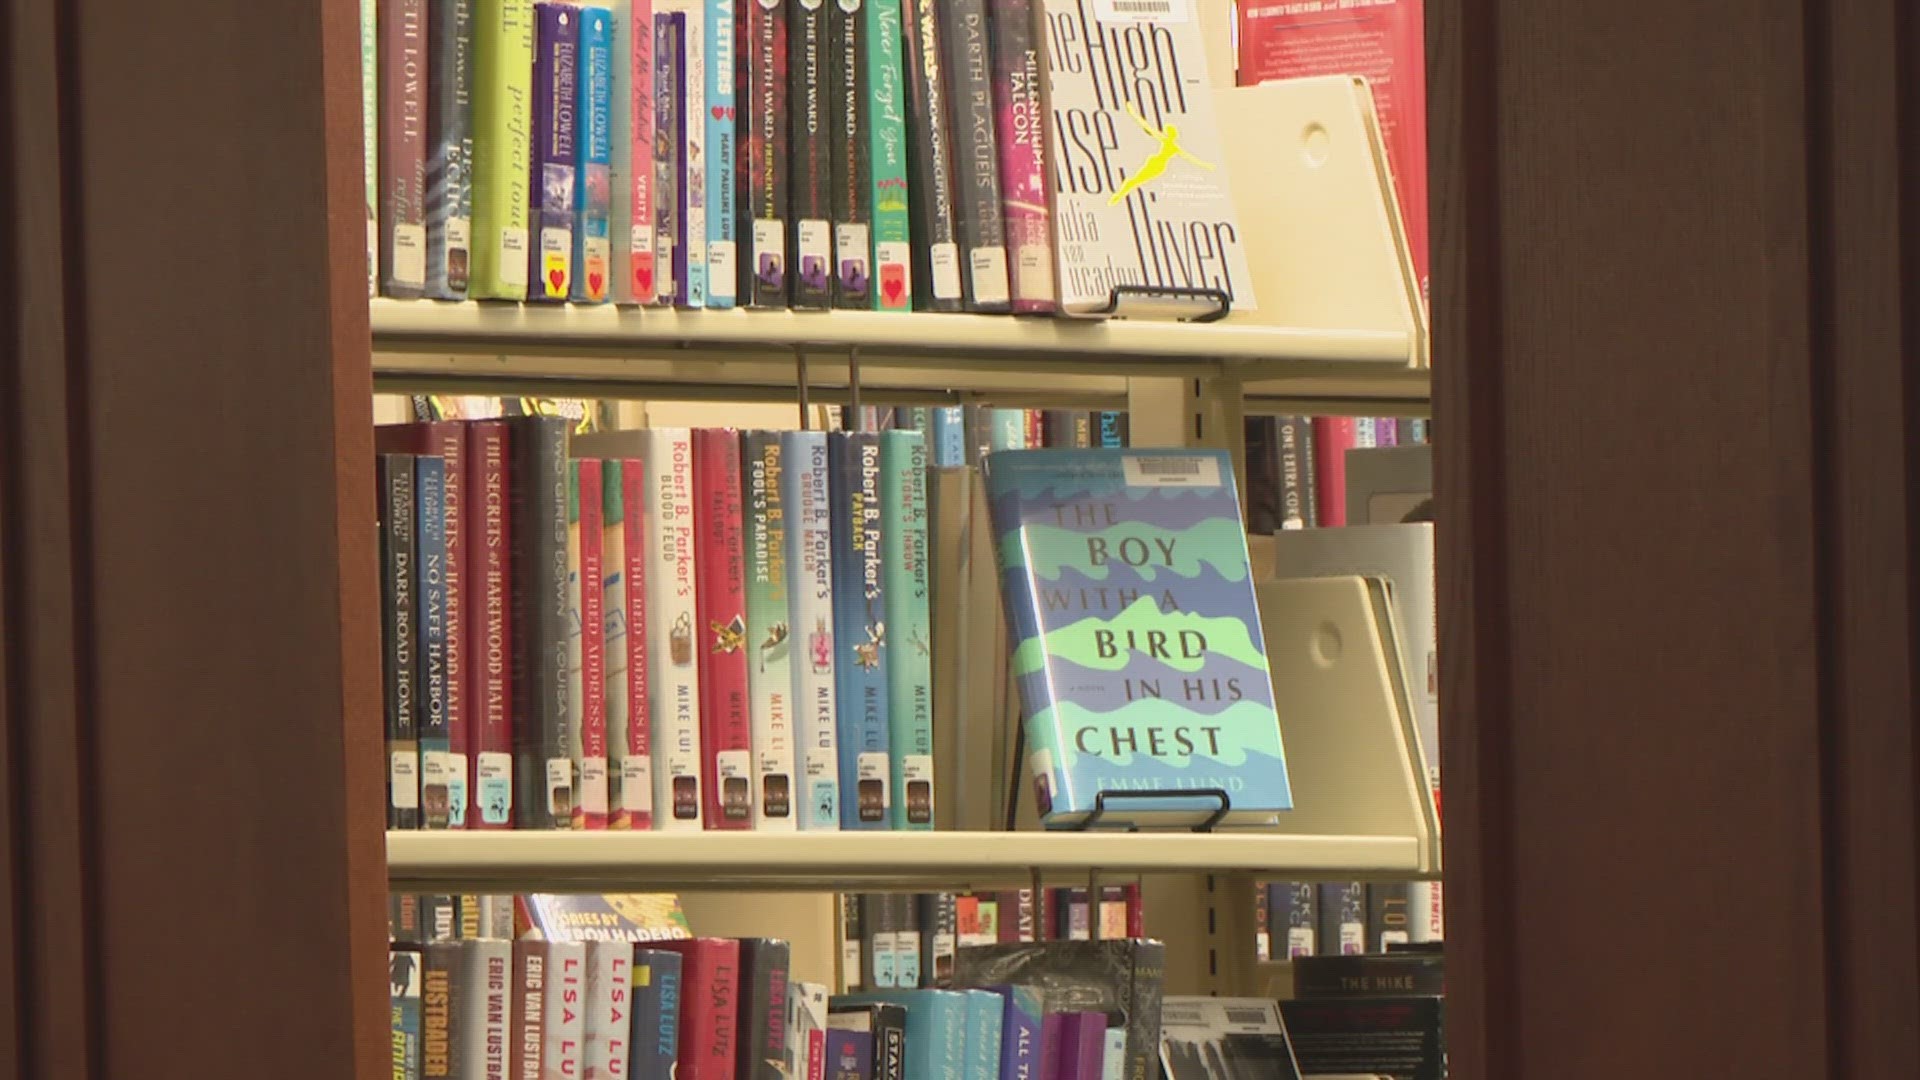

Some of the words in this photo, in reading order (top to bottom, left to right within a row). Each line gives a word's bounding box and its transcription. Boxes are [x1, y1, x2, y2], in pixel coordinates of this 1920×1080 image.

[763, 14, 774, 39] THE
[806, 15, 818, 40] THE
[845, 18, 857, 44] THE
[876, 2, 898, 54] Never
[965, 13, 984, 81] DARTH
[456, 37, 470, 105] lowell
[559, 43, 574, 100] ELIZABETH
[594, 47, 608, 103] ELIZABETH
[716, 17, 734, 95] LETTERS
[763, 46, 774, 87] FIFTH
[806, 44, 818, 84] FIFTH
[845, 48, 857, 87] FIFTH
[404, 48, 418, 143] LOWELL
[763, 91, 775, 138] WARD
[806, 87, 818, 133] WARD
[845, 91, 857, 136] WARD
[874, 64, 902, 123] Forget
[1010, 72, 1029, 144] FALCON
[506, 85, 526, 171] perfect
[558, 103, 573, 156] LOWELL
[594, 106, 608, 158] LOWELL
[720, 133, 731, 164] MARY
[971, 90, 992, 188] PLAGUEIS
[446, 144, 461, 219] ECHO
[764, 143, 775, 198] FRIENDLY
[636, 174, 648, 223] VERITY
[443, 437, 458, 466] THE
[486, 437, 502, 467] THE
[554, 428, 566, 476] TWO
[1281, 425, 1295, 449] ONE
[671, 440, 692, 498] Robert
[751, 460, 767, 510] FOOL'S
[764, 443, 783, 500] Robert
[811, 445, 829, 502] Robert
[861, 444, 880, 502] Robert
[911, 444, 927, 502] Robert
[443, 472, 460, 549] SECRETS
[486, 472, 503, 547] SECRETS
[554, 481, 567, 543] GIRLS
[660, 474, 674, 520] BLOOD
[675, 505, 689, 521] B.
[766, 508, 783, 521] B.
[814, 508, 828, 523] B.
[863, 508, 880, 523] B.
[913, 507, 926, 523] B.
[1049, 503, 1118, 527] THE
[662, 525, 675, 562] FEUD
[851, 492, 865, 550] PAYBACK
[427, 555, 440, 585] NO
[675, 526, 692, 598] Parker's
[753, 514, 769, 583] PARADISE
[765, 528, 785, 601] Parker's
[803, 528, 817, 572] MATCH
[814, 529, 832, 600] Parker's
[863, 529, 882, 600] Parker's
[912, 528, 928, 599] Parker's
[1087, 537, 1178, 567] BOY
[396, 552, 409, 604] DARK
[554, 550, 567, 617] DOWN
[586, 555, 599, 591] THE
[630, 556, 644, 591] THE
[428, 588, 442, 639] SAFE
[487, 570, 503, 674] HARTWOOD
[586, 598, 600, 635] RED
[631, 598, 645, 635] RED
[1040, 588, 1139, 613] WITH
[1158, 589, 1181, 611] A
[396, 610, 410, 664] ROAD
[445, 571, 461, 676] HARTWOOD
[1094, 629, 1209, 660] BIRD
[397, 669, 411, 728] HOME
[429, 643, 444, 728] HARBOR
[488, 678, 504, 724] HALL
[555, 640, 568, 723] LOUISA
[587, 644, 602, 728] ADDRESS
[632, 641, 646, 726] ADDRESS
[676, 684, 690, 721] MIKE
[864, 686, 878, 722] MIKE
[914, 684, 928, 722] MIKE
[1124, 678, 1163, 701] IN
[1183, 677, 1243, 701] HIS
[729, 690, 742, 727] MIKE
[770, 693, 784, 730] MIKE
[816, 686, 831, 723] MIKE
[1074, 725, 1223, 758] CHEST
[1096, 776, 1164, 791] EMME
[1176, 776, 1245, 791] LUND
[612, 927, 687, 943] HADERO
[488, 956, 504, 990] ERIC
[526, 955, 543, 989] ERIC
[563, 958, 579, 1025] LISA
[611, 958, 626, 1024] LISA
[660, 974, 677, 1011] LISA
[711, 965, 732, 1009] LISA
[769, 969, 786, 1005] LISA
[1341, 977, 1369, 990] THE
[1375, 976, 1414, 991] HIKE
[488, 993, 503, 1024] VAN
[525, 990, 542, 1022] VAN
[658, 1014, 675, 1057] LUTZ
[711, 1014, 731, 1058] LUTZ
[768, 1008, 785, 1050] LUTZ
[1018, 1026, 1030, 1057] ALL
[562, 1040, 576, 1076] LU
[609, 1039, 623, 1075] LU
[888, 1033, 899, 1078] STAY
